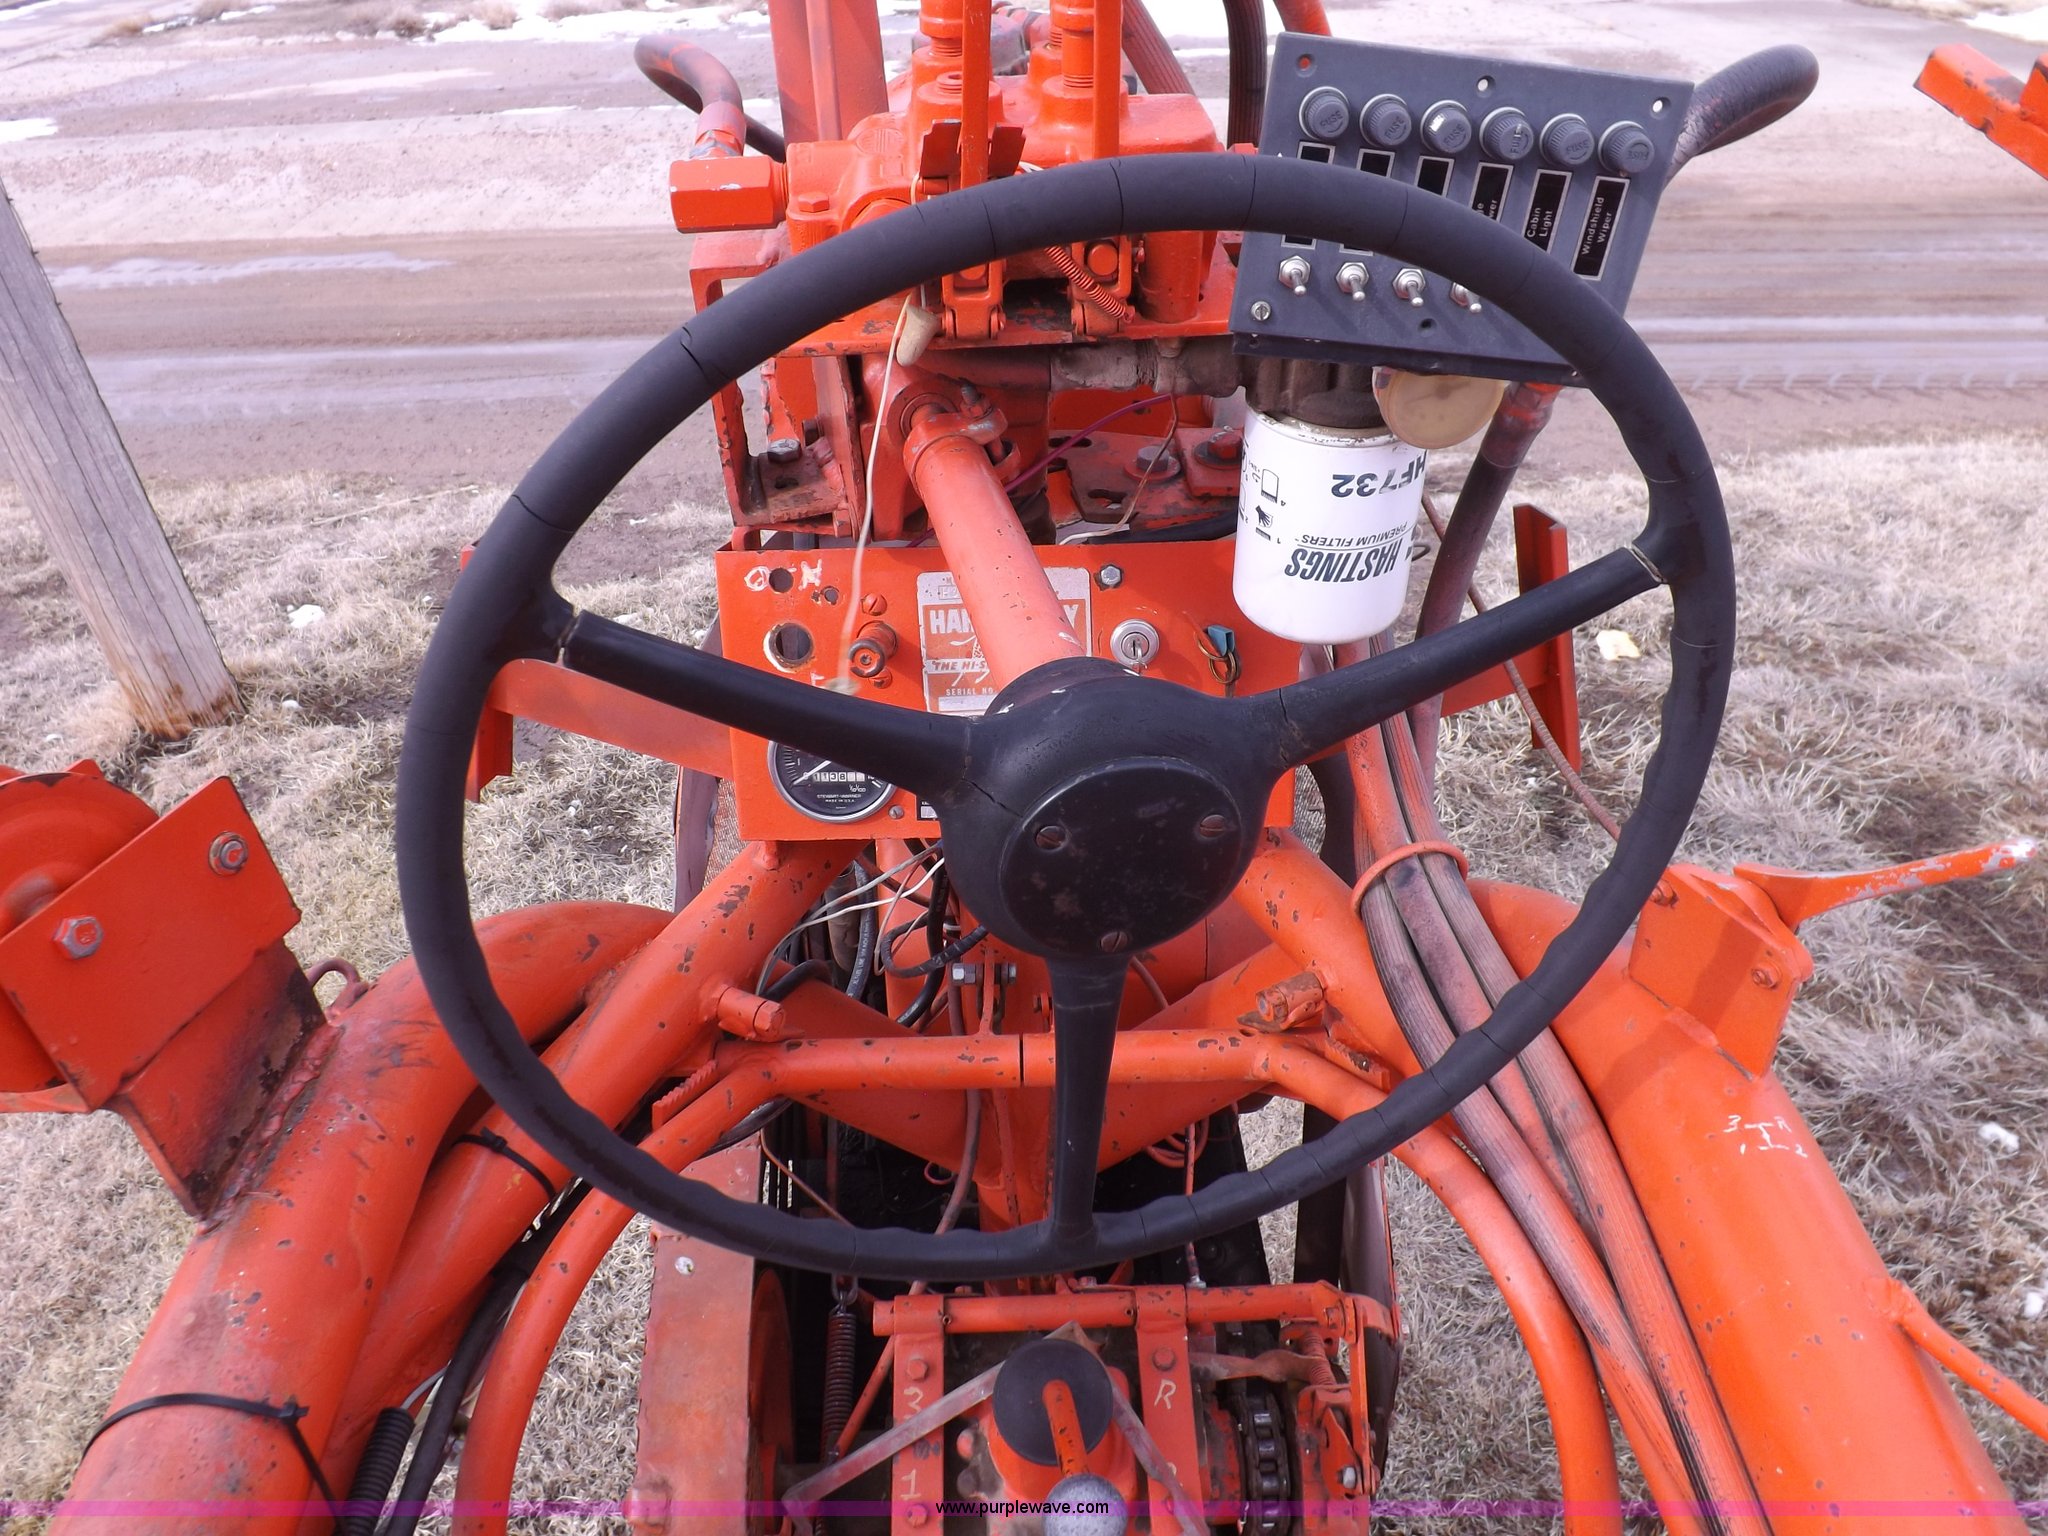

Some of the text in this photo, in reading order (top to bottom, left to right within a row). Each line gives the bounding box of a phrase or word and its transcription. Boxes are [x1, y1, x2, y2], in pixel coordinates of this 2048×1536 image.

[1319, 109, 1344, 127] FUSE
[1385, 115, 1405, 139] FUSE
[1443, 123, 1466, 145] FUSE
[1566, 139, 1590, 155] FUSE
[1627, 147, 1650, 160] FUSE
[1526, 207, 1542, 238] Cabin
[1538, 210, 1553, 237] Light
[1581, 196, 1605, 255] Windshield
[1597, 211, 1612, 243] Wiper
[1331, 449, 1427, 498] HF732
[1356, 521, 1408, 547] PREMIUM
[1284, 538, 1403, 583] HASTINGS
[945, 687, 977, 696] SERIAL
[1723, 1114, 1742, 1133] 3
[1154, 1379, 1177, 1410] R
[900, 1468, 922, 1501] 1
